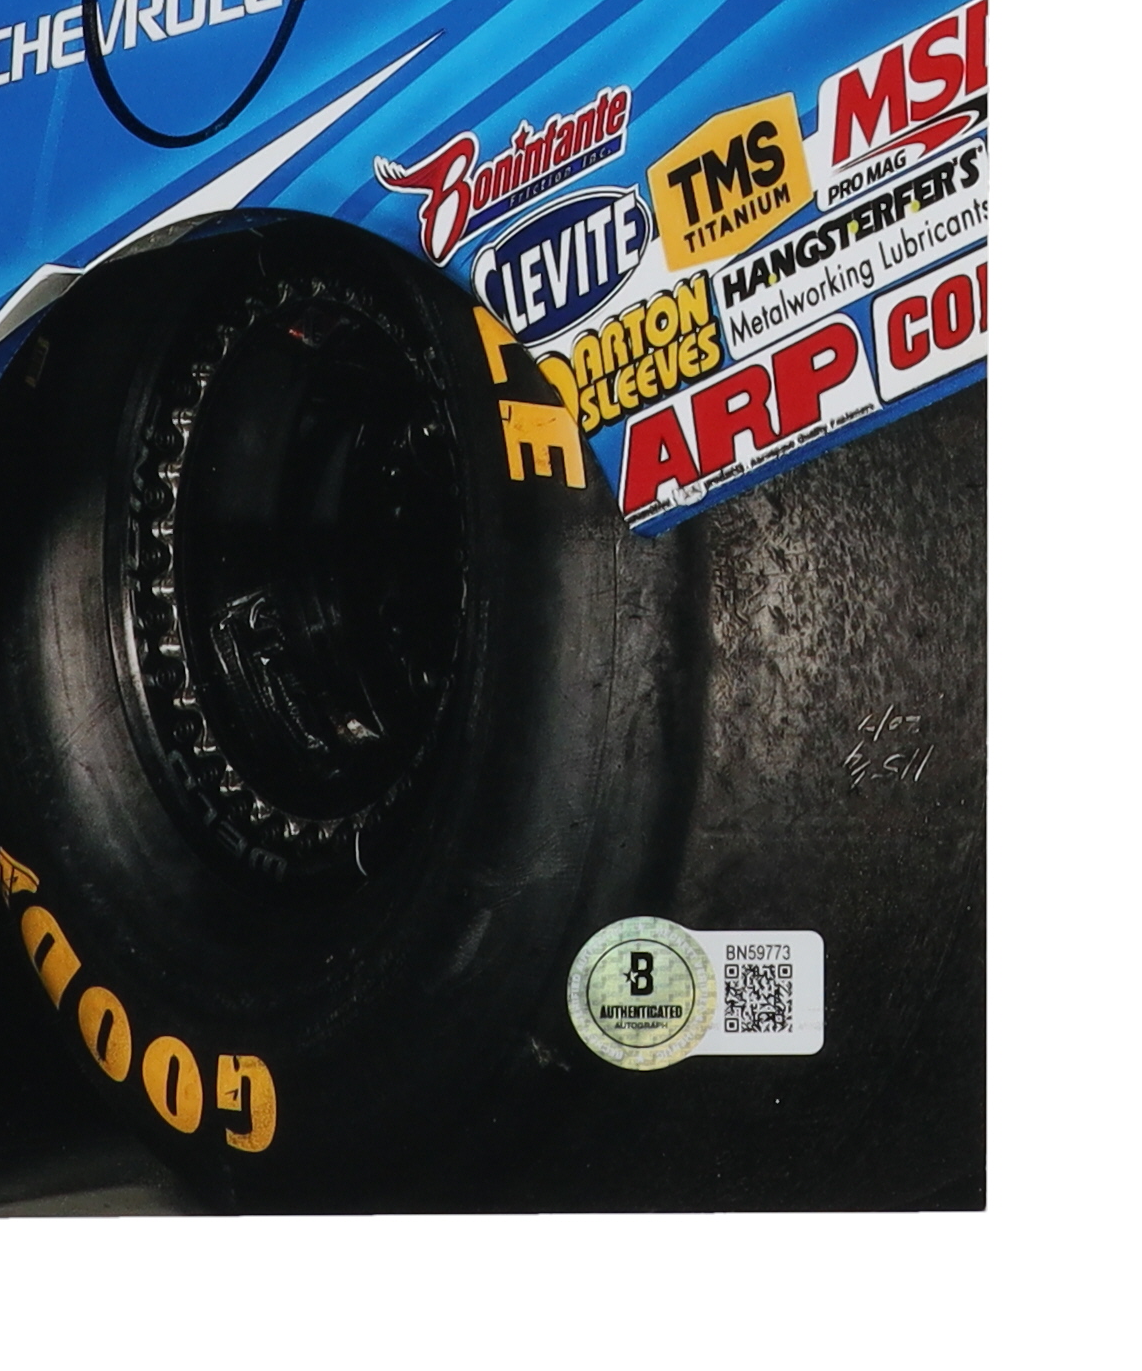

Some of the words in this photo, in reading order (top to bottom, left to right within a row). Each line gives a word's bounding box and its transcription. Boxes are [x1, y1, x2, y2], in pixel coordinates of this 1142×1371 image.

[508, 164, 573, 208] Friction
[581, 148, 612, 168] Inc.
[667, 120, 786, 226] TMS
[827, 172, 864, 206] PRO
[866, 148, 908, 183] MAG
[474, 190, 640, 334] CLEVITE
[683, 183, 791, 254] TITANIUM
[721, 149, 982, 309] HANGSTERFER'S
[729, 258, 875, 347] Metalworking
[886, 262, 989, 372] CO
[579, 322, 721, 433] SLEEVES
[623, 322, 859, 517] ARP
[725, 944, 792, 961] BN59773
[599, 1005, 683, 1020] AUTHENTICATED
[614, 1021, 669, 1030] AUTOGRAPH
